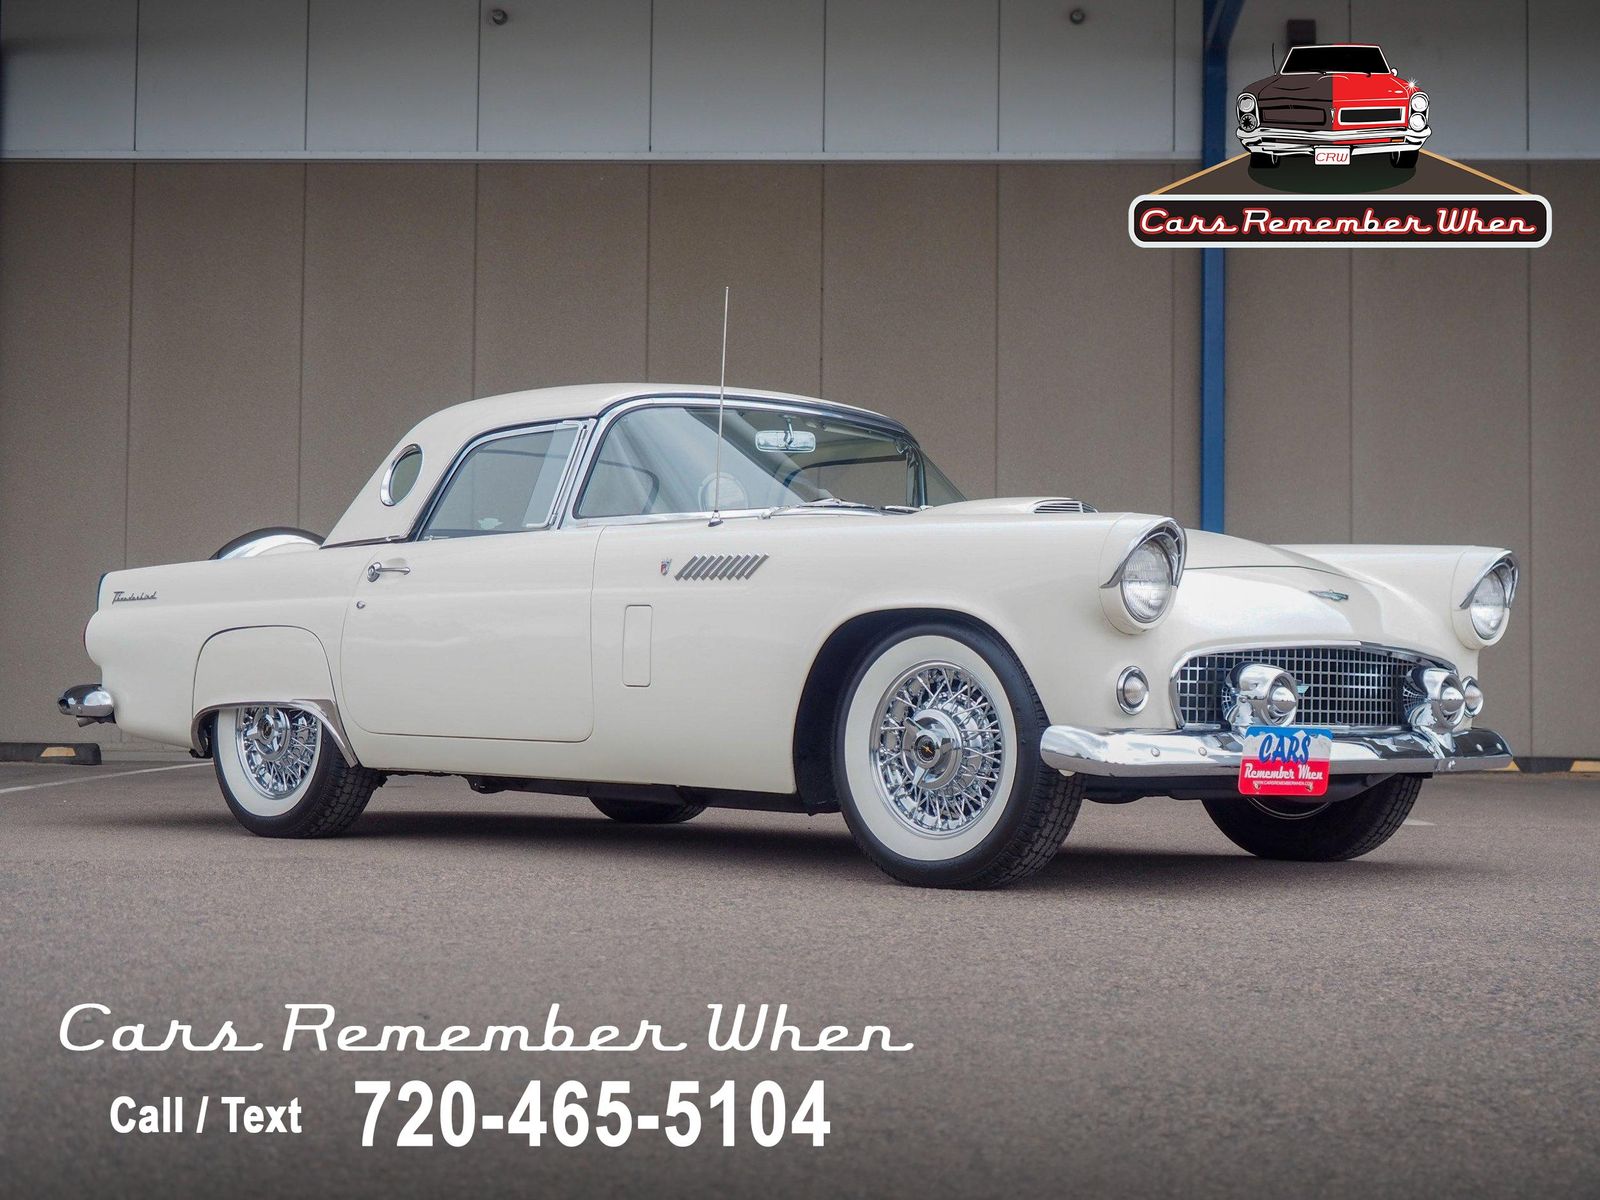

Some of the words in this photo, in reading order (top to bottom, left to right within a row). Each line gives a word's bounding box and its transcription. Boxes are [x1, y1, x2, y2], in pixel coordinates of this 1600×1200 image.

[1259, 734, 1311, 764] CARS
[1244, 763, 1294, 779] Remember
[1298, 764, 1323, 780] When
